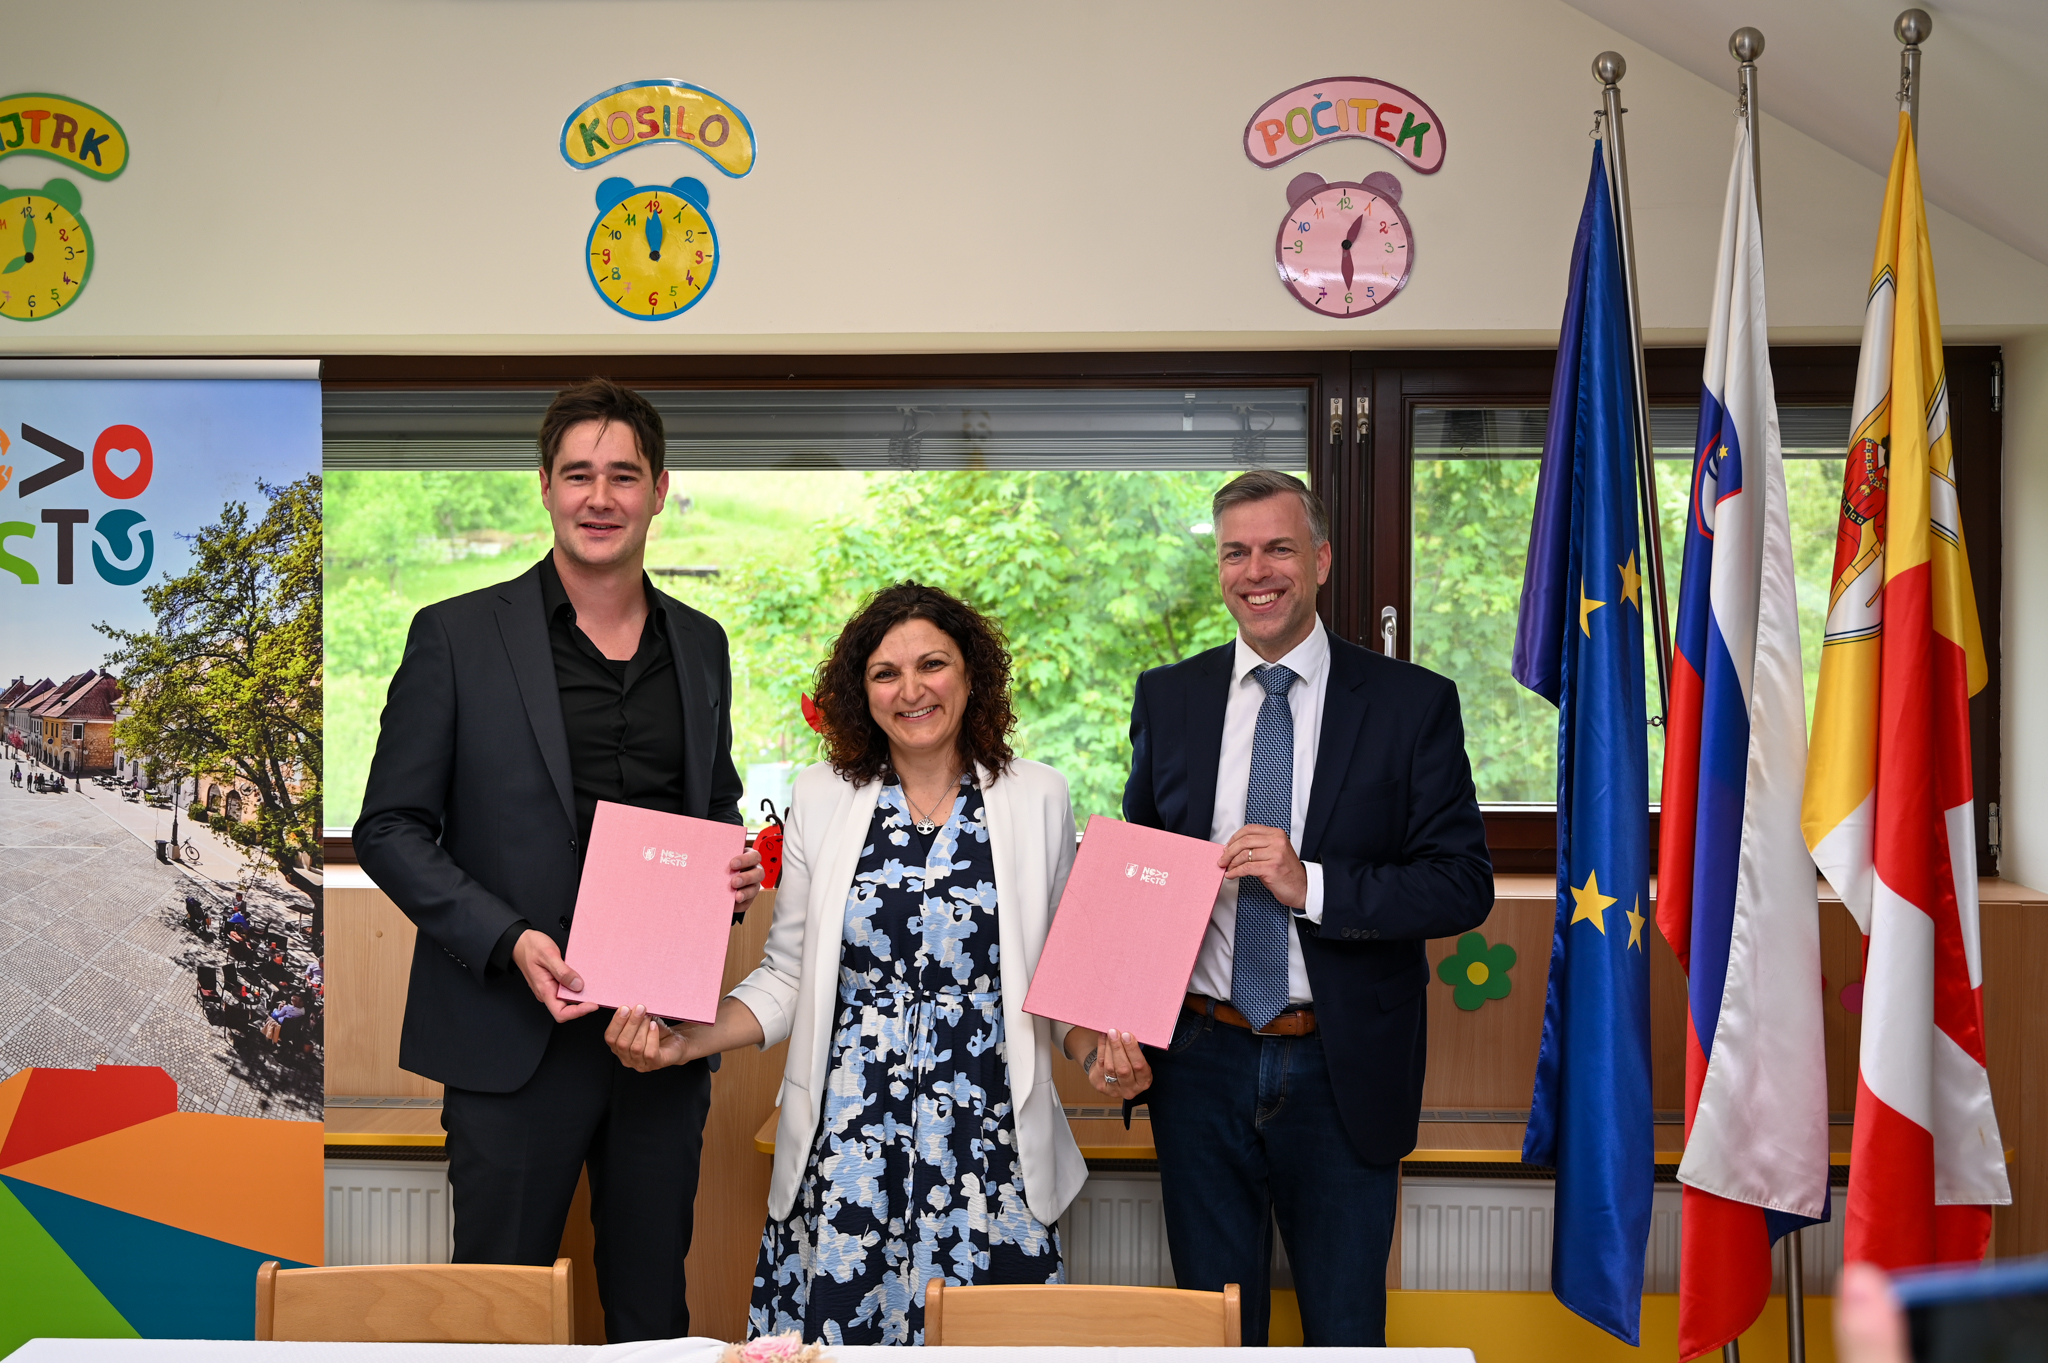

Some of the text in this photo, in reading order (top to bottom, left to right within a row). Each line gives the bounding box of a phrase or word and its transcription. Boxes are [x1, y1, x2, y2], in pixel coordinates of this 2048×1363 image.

[579, 105, 730, 157] KOSILO
[1255, 93, 1431, 158] POČITEK
[0, 110, 110, 167] JTRK
[644, 200, 663, 214] 12
[1336, 196, 1354, 211] 12
[1364, 202, 1372, 217] 1
[21, 206, 36, 219] 12
[45, 212, 53, 224] 1
[673, 211, 682, 224] 1
[1314, 207, 1325, 219] 11
[624, 213, 637, 226] 11
[1297, 221, 1311, 233] 10
[1379, 221, 1389, 234] 2
[59, 228, 69, 242] 2
[608, 229, 622, 240] 10
[684, 229, 694, 243] 2
[64, 246, 75, 260] 3
[1294, 240, 1304, 254] 9
[1384, 242, 1394, 253] 3
[602, 248, 611, 265] 9
[611, 267, 621, 280] 8
[685, 269, 694, 286] 4
[1381, 265, 1389, 277] 4
[63, 271, 71, 285] 4
[51, 288, 60, 300] 5
[623, 281, 632, 294] 7
[669, 285, 678, 297] 5
[1317, 286, 1328, 299] 7
[1366, 286, 1375, 298] 5
[2, 290, 12, 302] 7
[28, 295, 36, 308] 6
[648, 291, 659, 306] 6
[1344, 292, 1353, 304] 6
